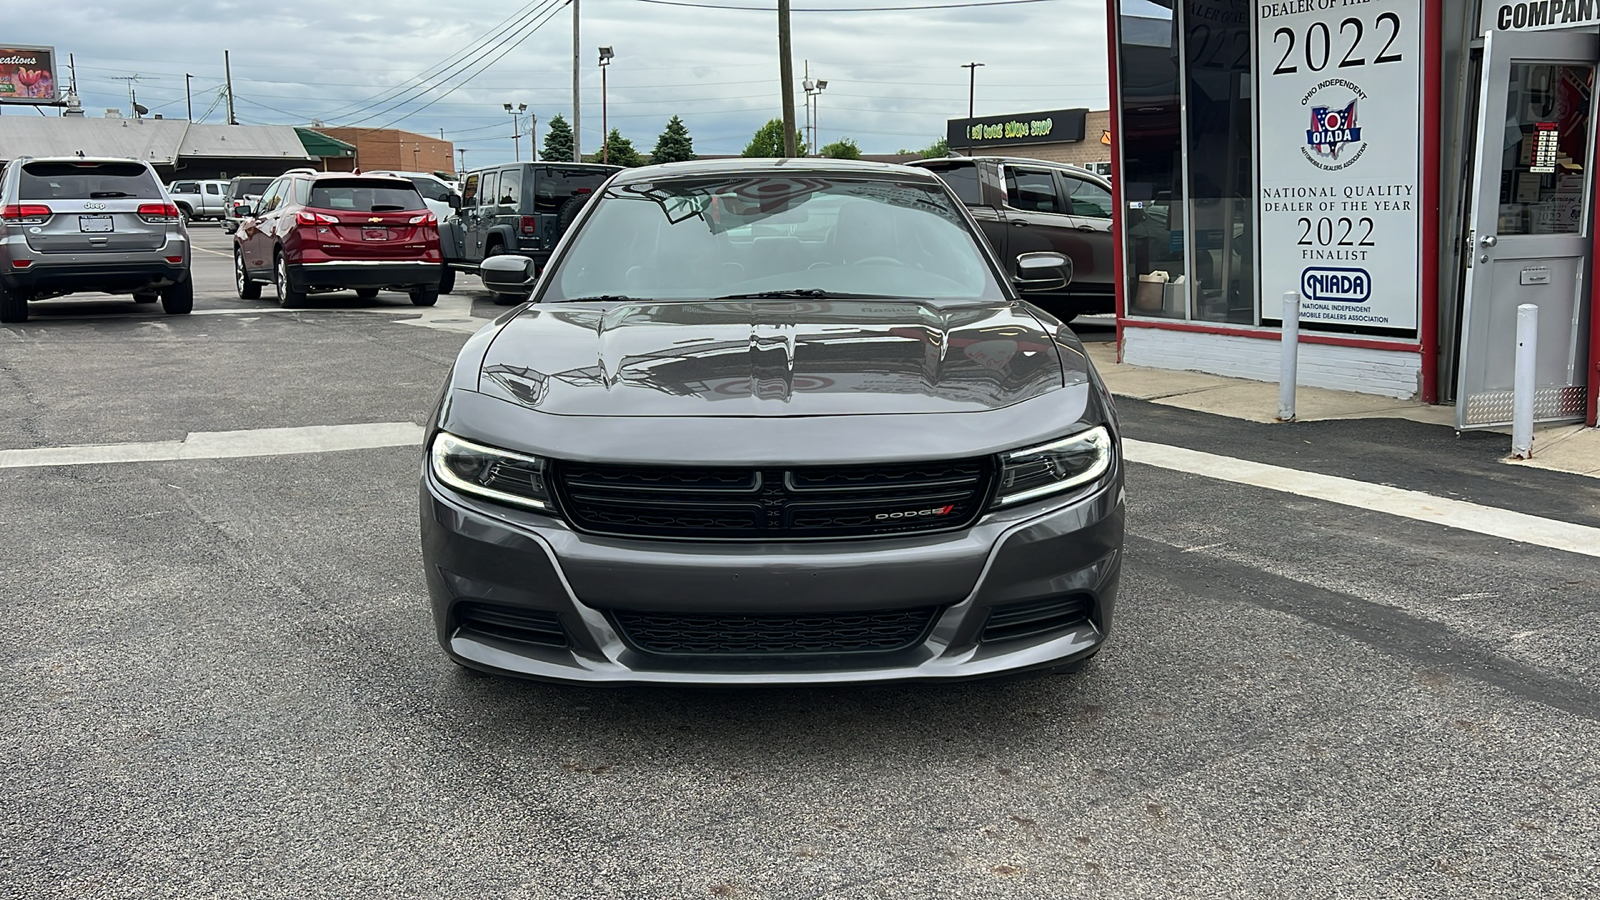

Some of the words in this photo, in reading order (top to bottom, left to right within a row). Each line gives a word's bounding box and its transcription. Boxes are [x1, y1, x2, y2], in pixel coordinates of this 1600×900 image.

[1261, 0, 1314, 18] DEALER
[1497, 0, 1600, 30] COMPAN
[1273, 11, 1403, 75] 2022
[1301, 87, 1318, 105] OHIO
[1317, 79, 1367, 100] INDEPENDENT
[1030, 117, 1053, 136] SHOP
[1312, 129, 1352, 143] OIADA
[1300, 146, 1323, 170] AUTOMOBILE
[1322, 163, 1343, 171] DEALERS
[1343, 142, 1368, 168] ASSOCIATION
[1263, 187, 1337, 198] NATIONAL
[1343, 185, 1413, 199] QUALITY
[84, 202, 106, 211] Jeep
[1264, 202, 1313, 212] DEALER
[1319, 202, 1336, 212] OF
[1341, 201, 1368, 211] THE
[1374, 200, 1411, 211] YEAR
[1297, 217, 1376, 247] 2022
[1302, 249, 1368, 261] FINALIST
[1306, 274, 1365, 296] NIADA
[1301, 303, 1330, 311] NATIONAL
[1331, 304, 1371, 313] INDEPENDENT
[1299, 311, 1321, 319] MOBILE
[1322, 312, 1347, 321] DEALERS
[1348, 315, 1389, 323] ASSOCIATION
[875, 507, 944, 519] DODGE
